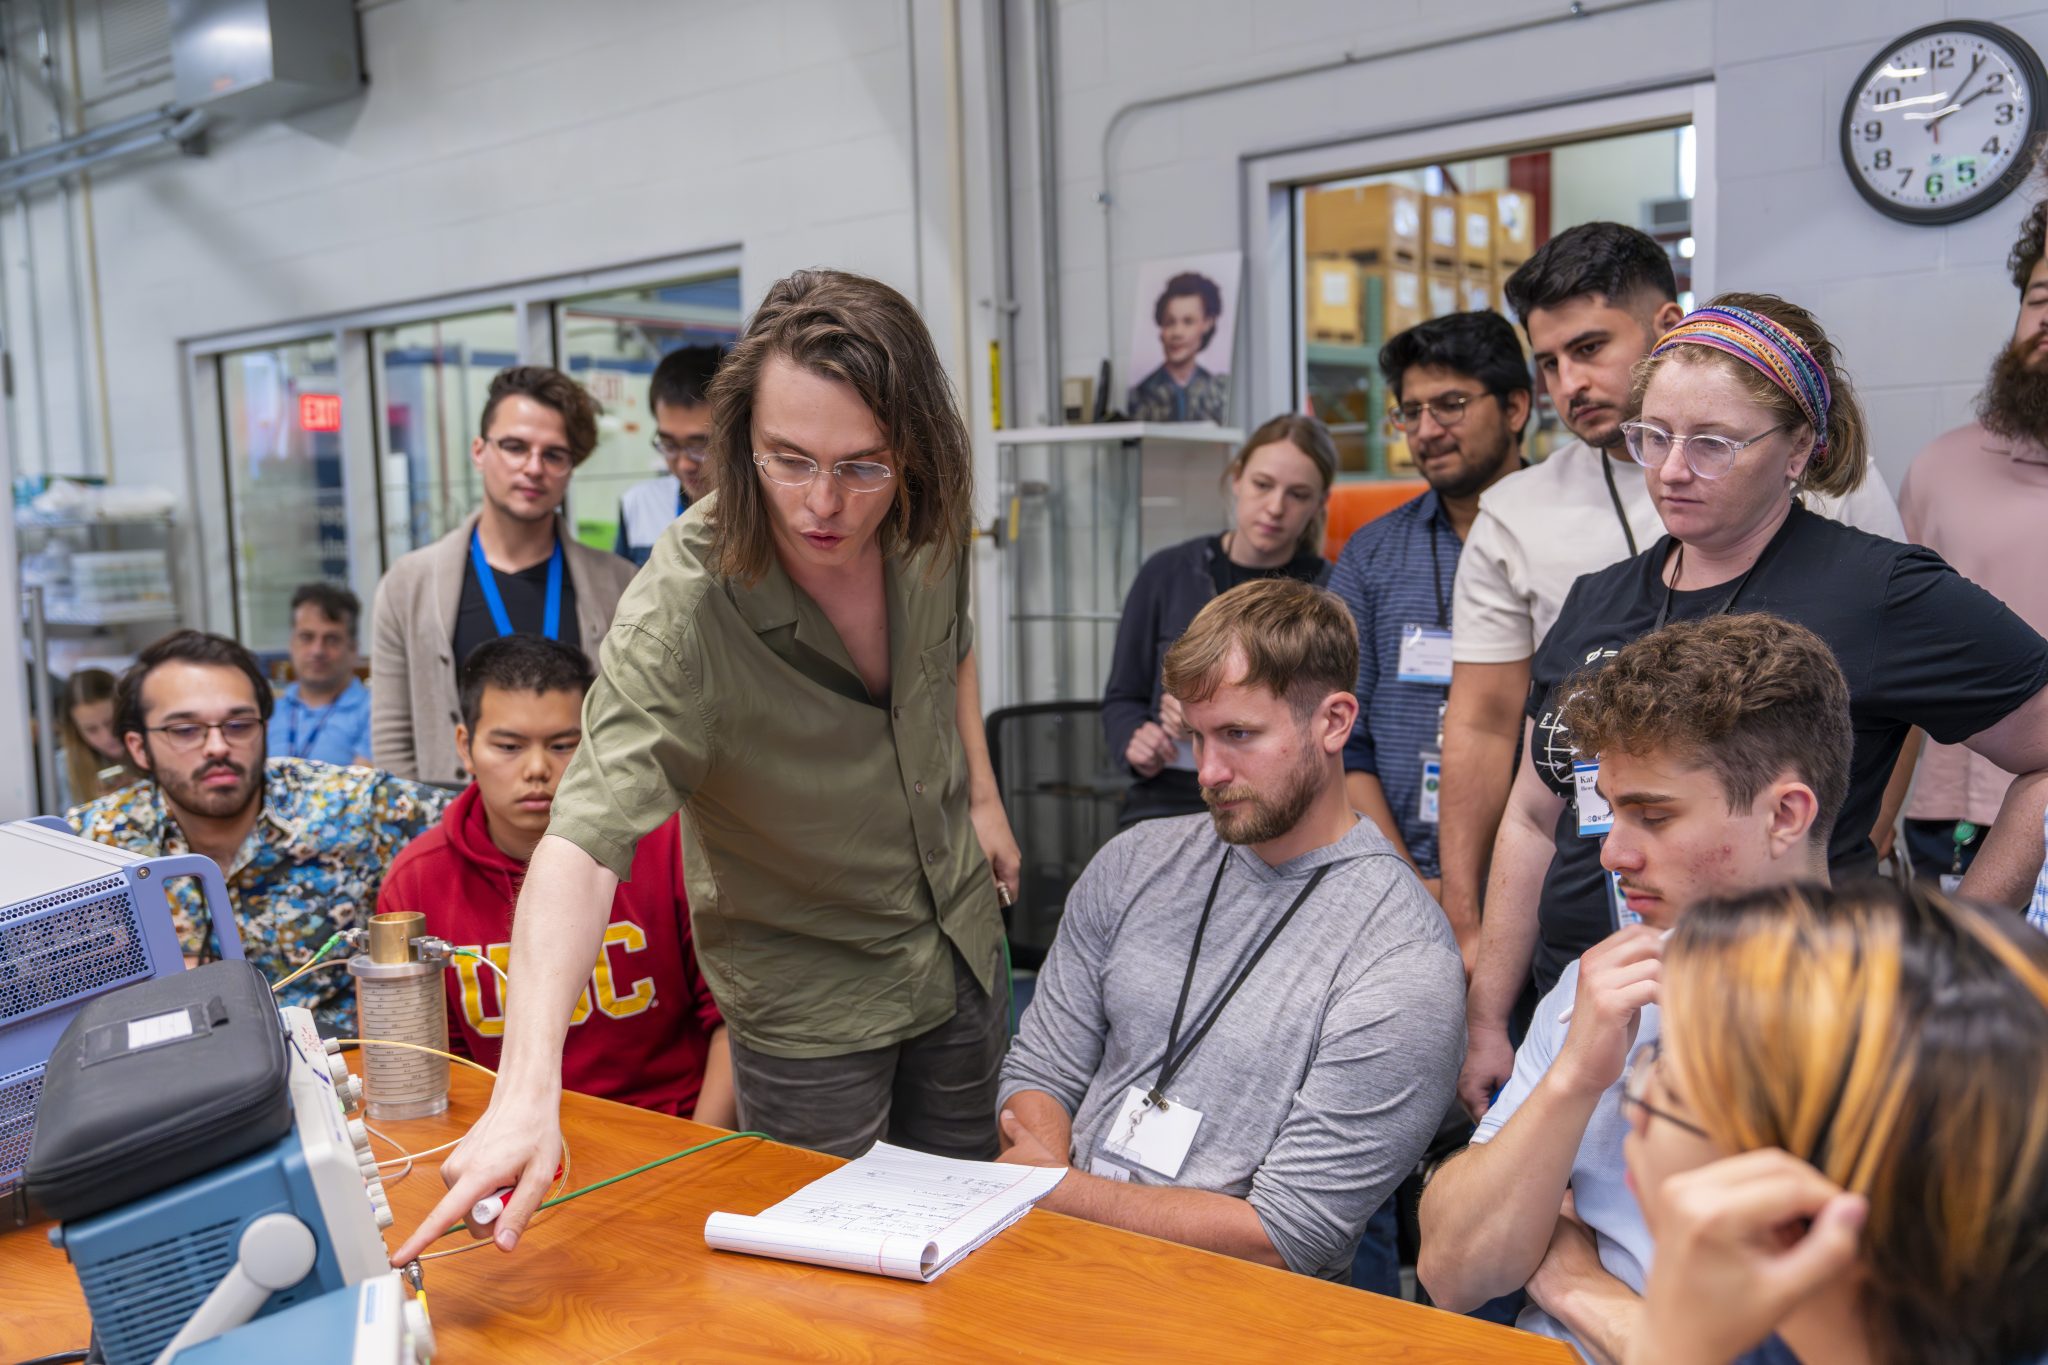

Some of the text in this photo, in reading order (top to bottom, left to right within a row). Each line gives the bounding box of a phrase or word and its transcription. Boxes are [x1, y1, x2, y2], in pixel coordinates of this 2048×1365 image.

[1929, 46, 1956, 70] 12
[1986, 72, 2004, 95] 2
[1875, 87, 1901, 107] 10
[1994, 103, 2014, 126] 3
[1864, 120, 1882, 142] 9
[1981, 135, 2000, 156] 4
[1873, 149, 1892, 171] 8
[1897, 167, 1914, 189] 7
[1957, 160, 1976, 183] 5
[1925, 173, 1944, 196] 6
[1580, 775, 1594, 784] Kat
[452, 920, 657, 1037] UC
